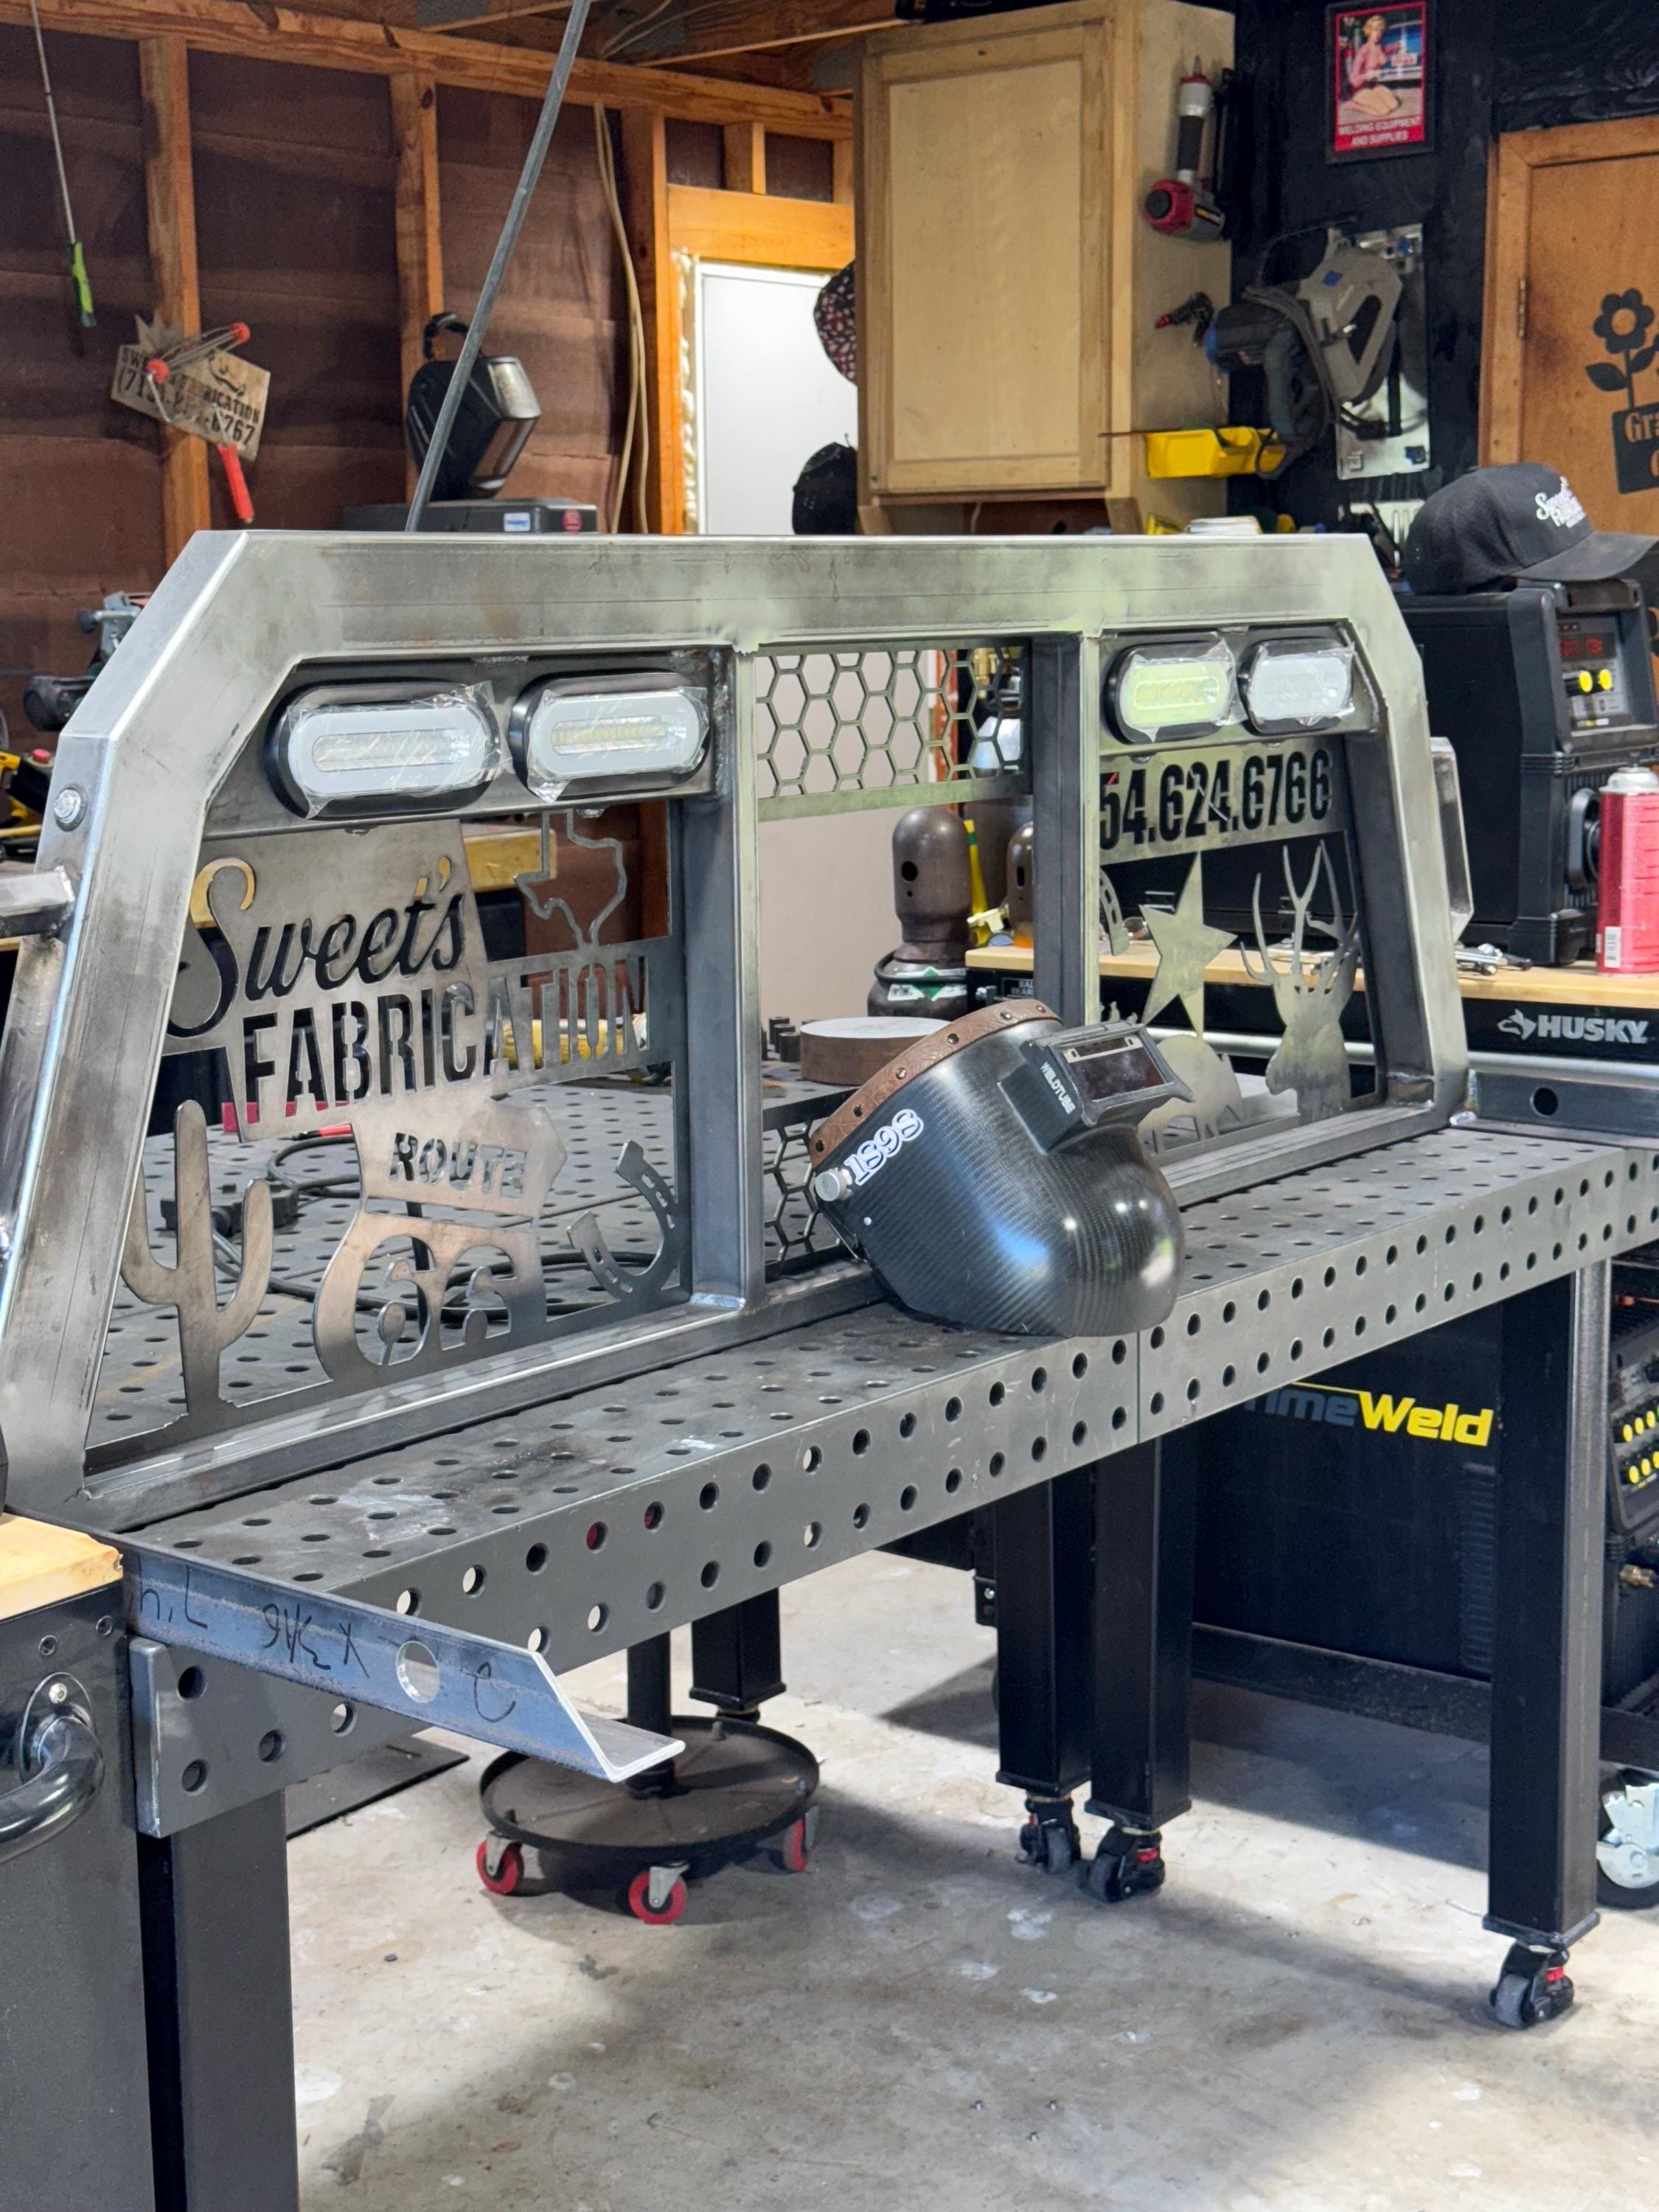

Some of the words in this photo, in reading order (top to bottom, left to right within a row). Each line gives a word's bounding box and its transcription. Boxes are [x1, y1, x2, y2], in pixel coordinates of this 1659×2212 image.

[167, 856, 465, 1038] Sweet's
[242, 956, 650, 1124] FABRICATION
[1537, 1014, 1649, 1044] HUSKY
[1040, 1061, 1076, 1114] WELDTUBE
[389, 1132, 528, 1198] ROUTE
[844, 1108, 925, 1186] 1898
[1243, 1388, 1494, 1447] imeWeld
